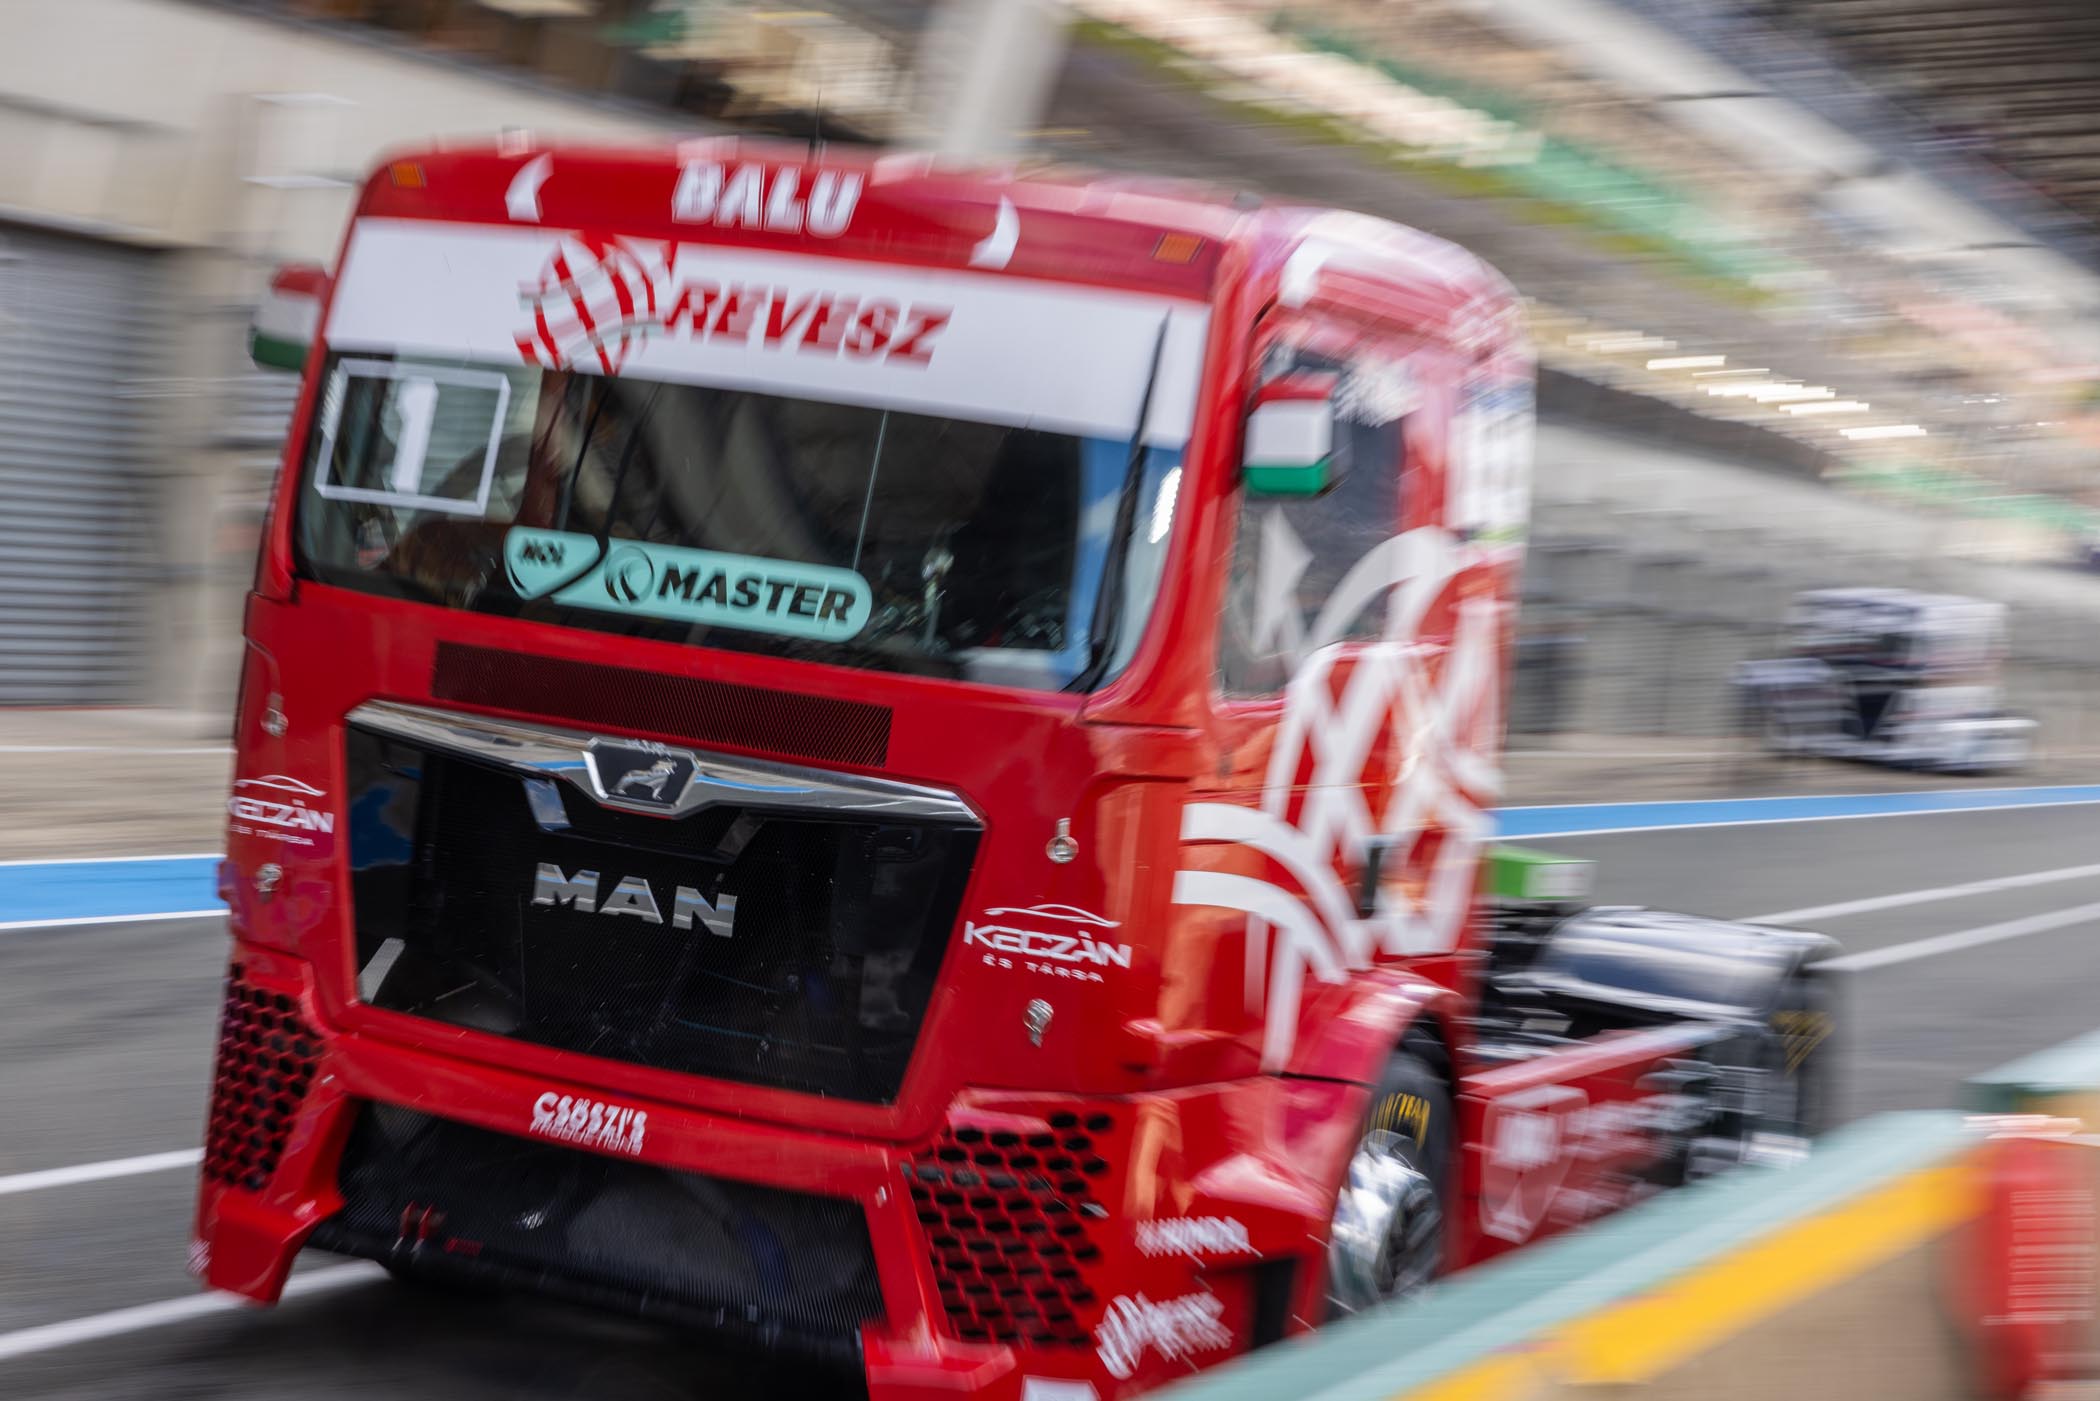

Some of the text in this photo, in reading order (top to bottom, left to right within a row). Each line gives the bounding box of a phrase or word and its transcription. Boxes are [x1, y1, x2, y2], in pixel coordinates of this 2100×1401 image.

[672, 159, 866, 239] BALU
[392, 375, 439, 495] 1
[657, 562, 857, 624] MASTER
[531, 861, 738, 938] MAN
